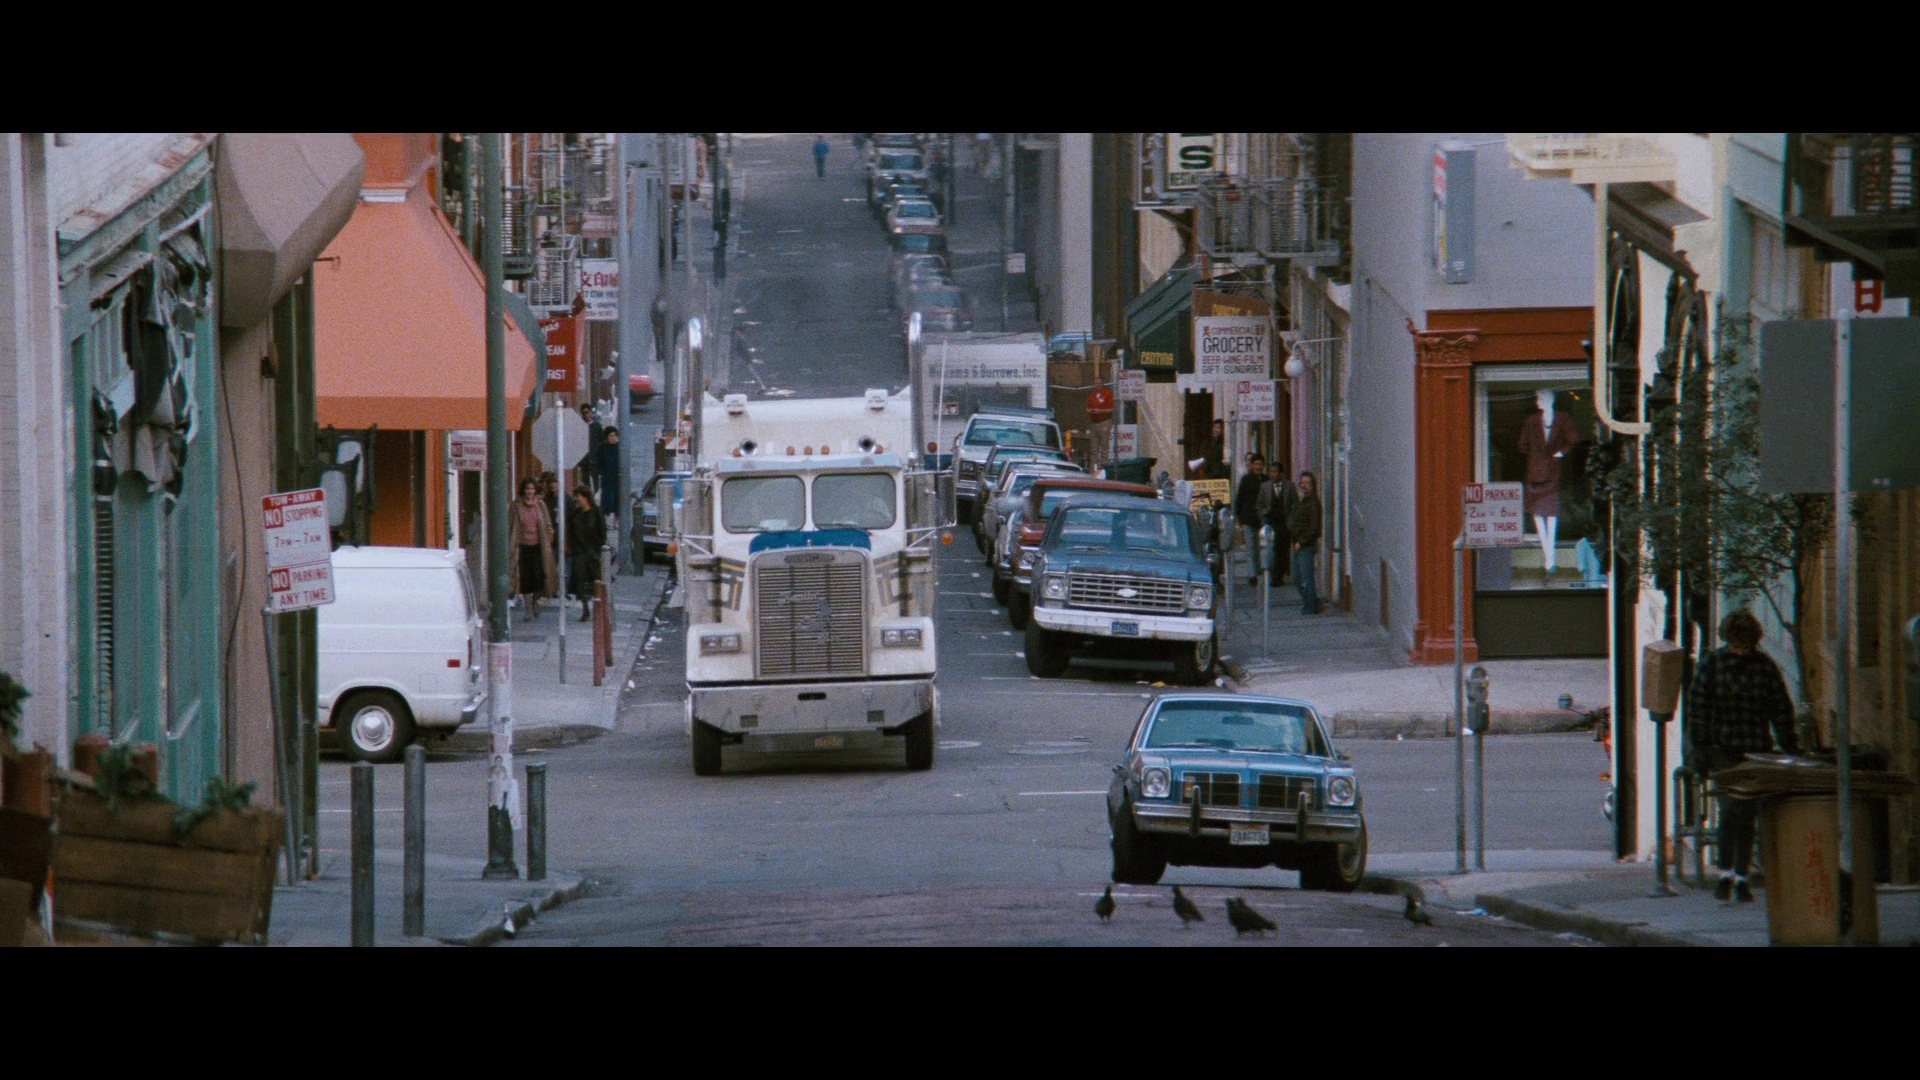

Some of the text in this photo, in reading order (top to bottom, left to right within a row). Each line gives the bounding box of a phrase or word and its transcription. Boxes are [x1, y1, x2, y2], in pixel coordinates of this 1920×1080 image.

[1203, 337, 1263, 353] GROCERY
[547, 369, 567, 380] FAST
[1202, 365, 1220, 374] GIFT
[1465, 486, 1520, 502] NO PARKING
[264, 505, 323, 528] NO STOPPING
[1469, 523, 1487, 532] TUES
[271, 567, 329, 591] NO PARKING
[281, 588, 327, 605] ANY TIME
